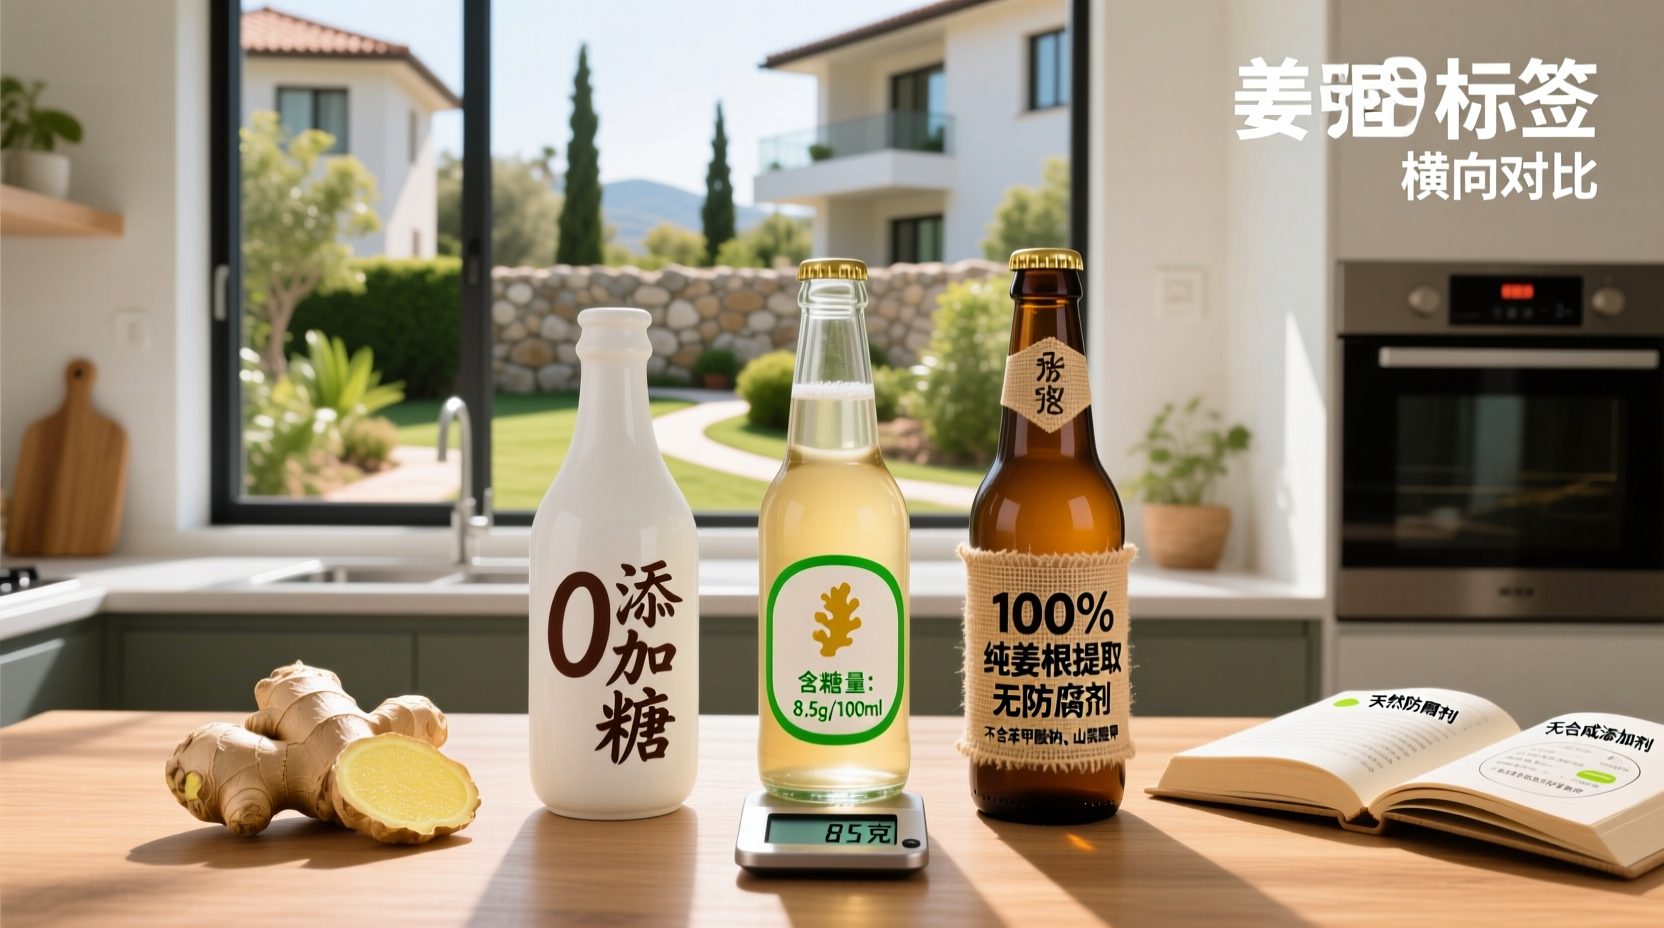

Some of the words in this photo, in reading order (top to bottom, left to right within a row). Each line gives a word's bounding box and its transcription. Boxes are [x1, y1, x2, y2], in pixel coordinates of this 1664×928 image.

[992, 590, 1114, 635] 100%
[547, 571, 611, 678] 0
[594, 560, 684, 765] 添加糖
[983, 641, 1122, 678] 纯姜根提取
[792, 699, 882, 722] 8.5g/100ml
[992, 681, 1111, 718] 无防腐剂
[825, 823, 892, 844] 85克
